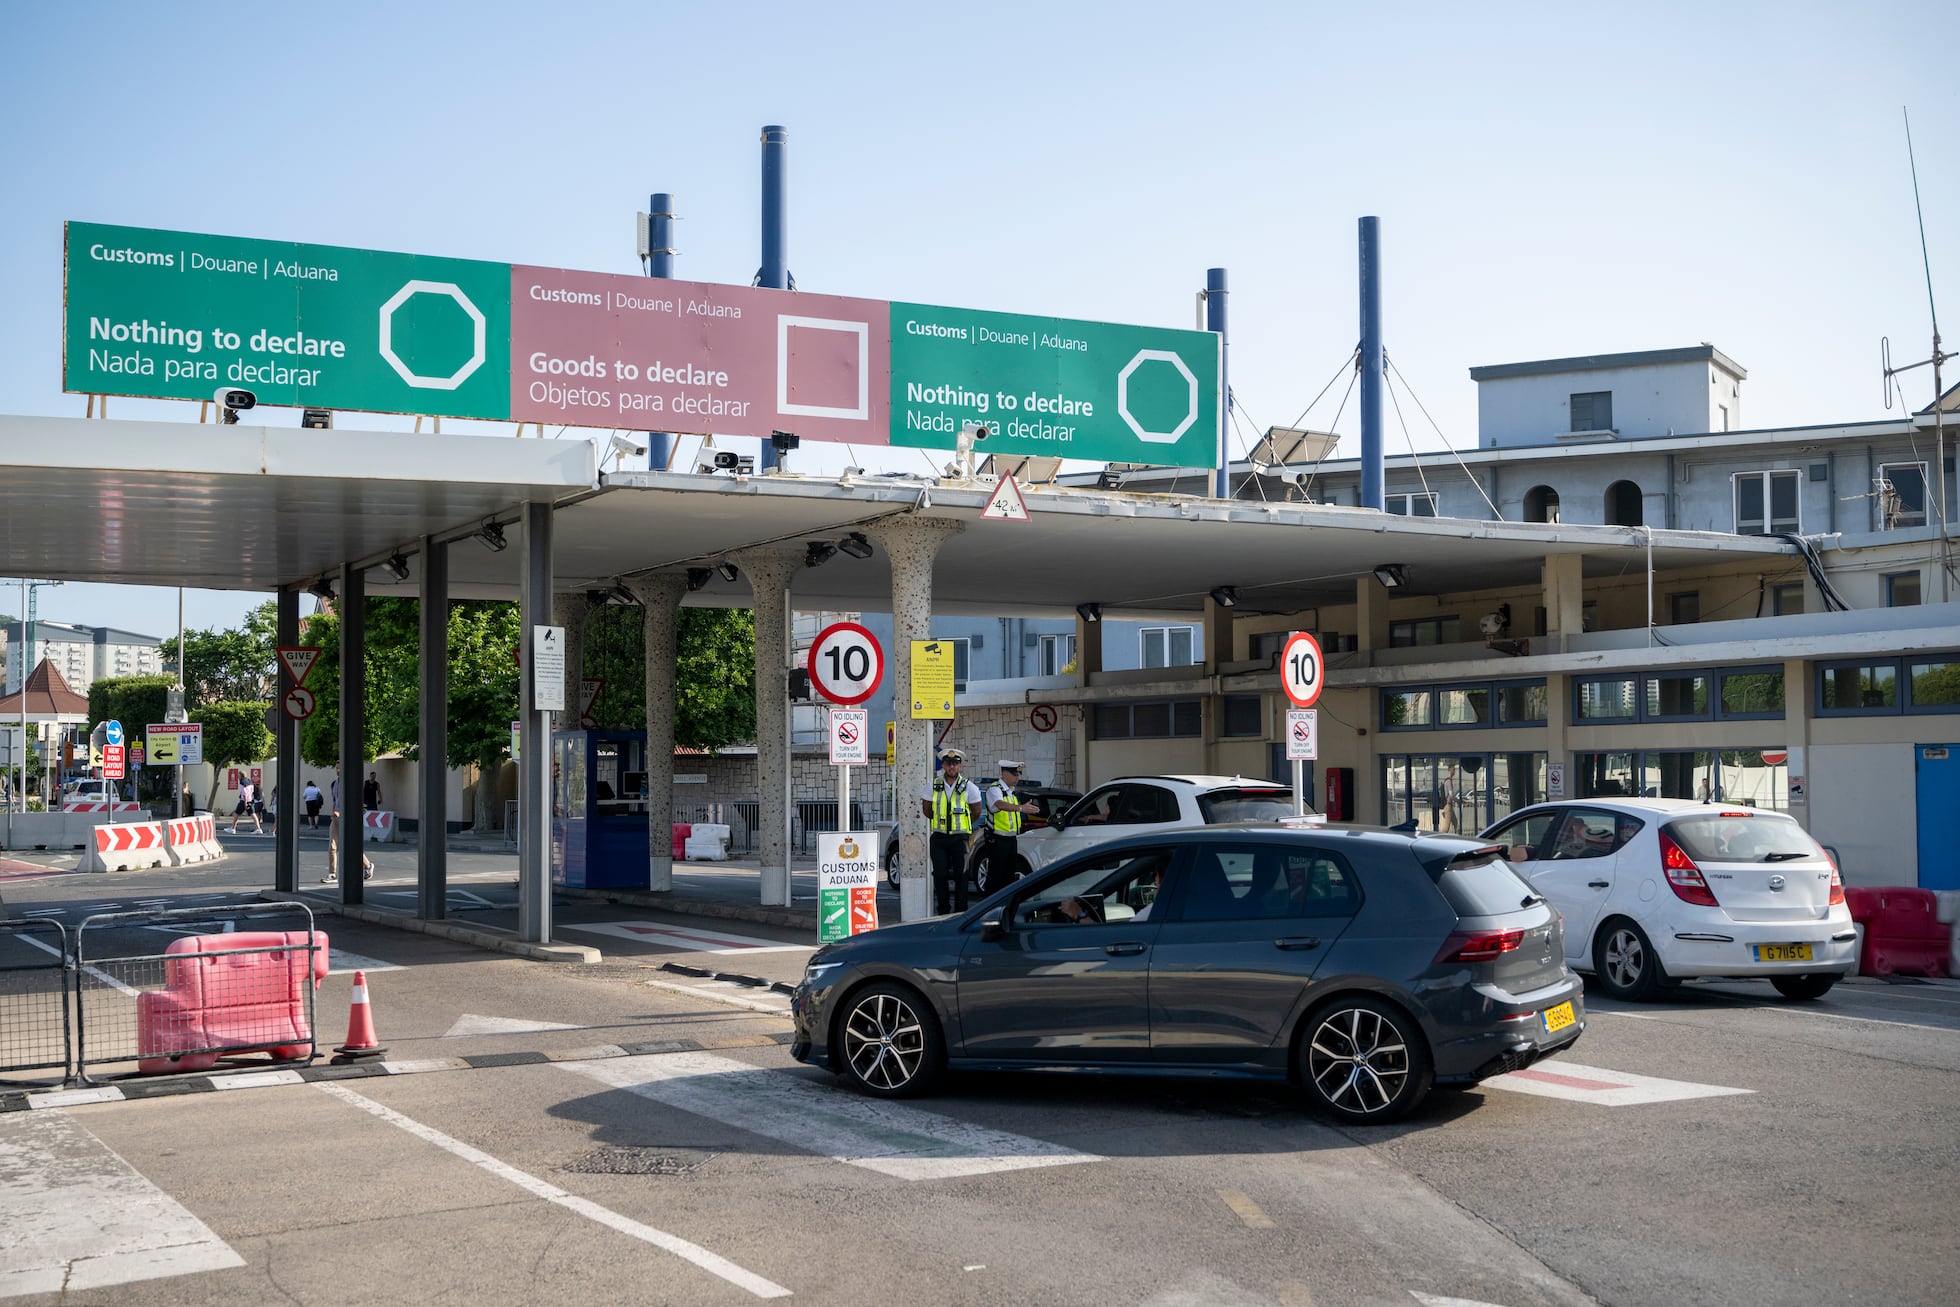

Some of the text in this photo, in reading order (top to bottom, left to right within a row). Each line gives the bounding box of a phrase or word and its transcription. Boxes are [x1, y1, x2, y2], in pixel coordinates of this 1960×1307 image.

[91, 245, 338, 281] Customs Douane Aduana
[530, 285, 742, 319] Customs Douane Aduana
[91, 317, 346, 359] Nothing to declare
[907, 320, 1088, 352] Customs Douane Aduana
[90, 349, 321, 387] Nada para declarar
[529, 352, 729, 387] Goods to declare
[529, 381, 750, 417] Objetos para declarar
[907, 382, 1094, 417] Nothing to declare
[907, 410, 955, 433] Nada
[1007, 417, 1076, 442] declarar
[286, 652, 312, 660] GIVE
[824, 645, 870, 682] 10
[1290, 653, 1315, 686] 10
[582, 682, 595, 691] IVE
[821, 861, 876, 874] CUSTOMS
[829, 874, 869, 885] ADUANA
[1797, 946, 1805, 958] C
